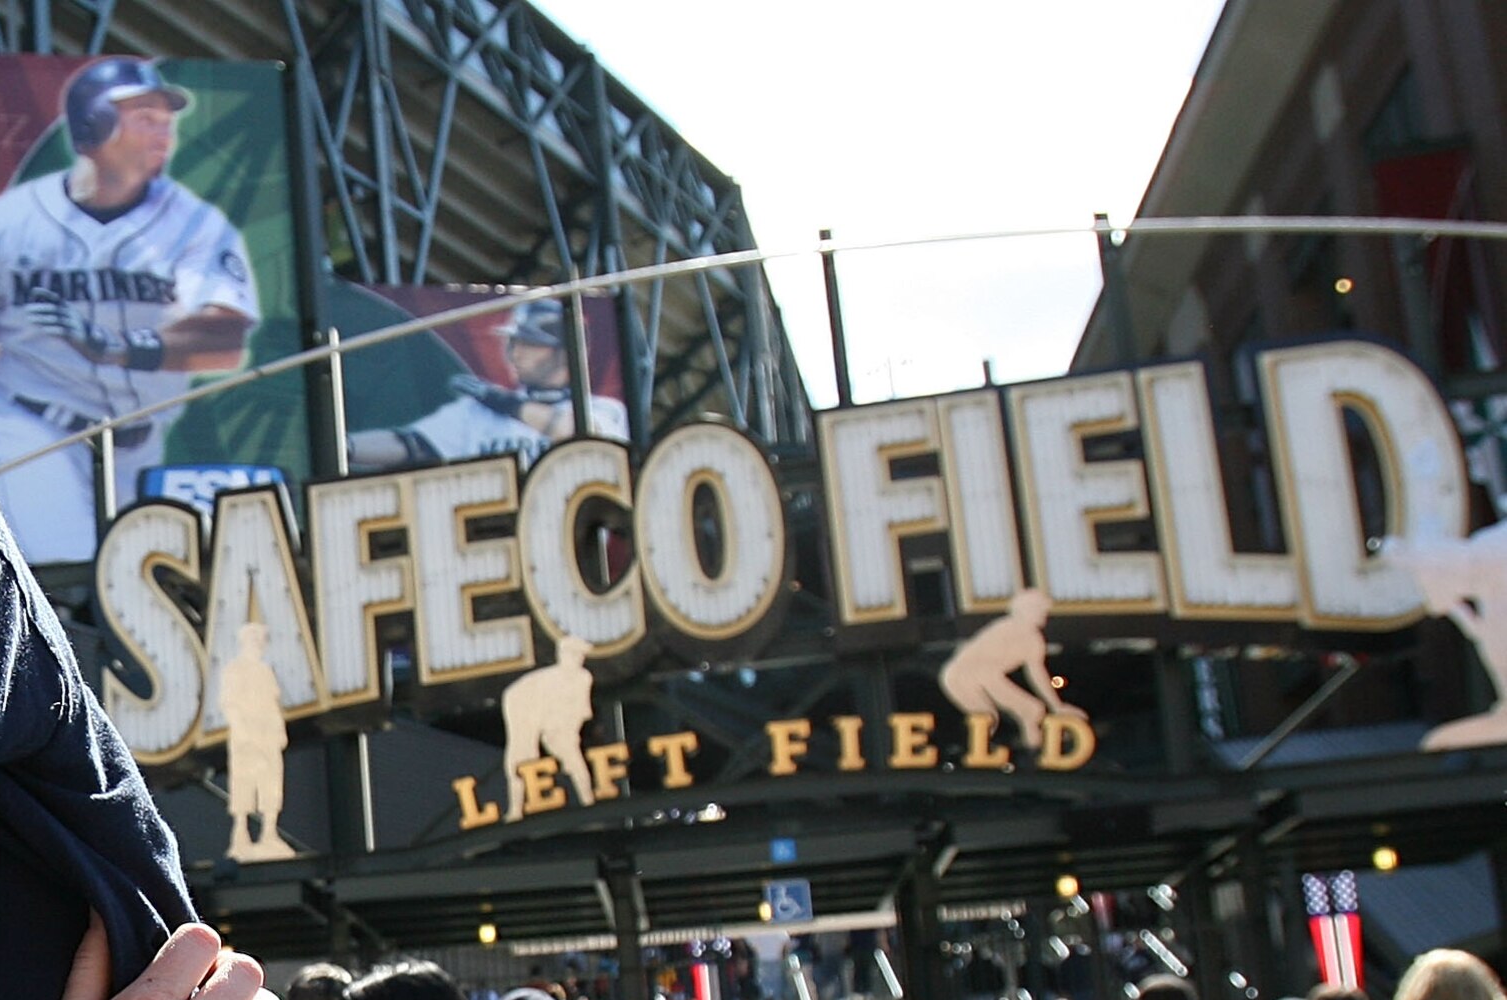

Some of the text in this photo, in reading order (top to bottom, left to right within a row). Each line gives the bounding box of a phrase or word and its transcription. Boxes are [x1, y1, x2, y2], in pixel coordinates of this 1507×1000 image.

[96, 340, 1471, 766] SAFECO FIELD
[452, 712, 1096, 829] LEFT FIELD
